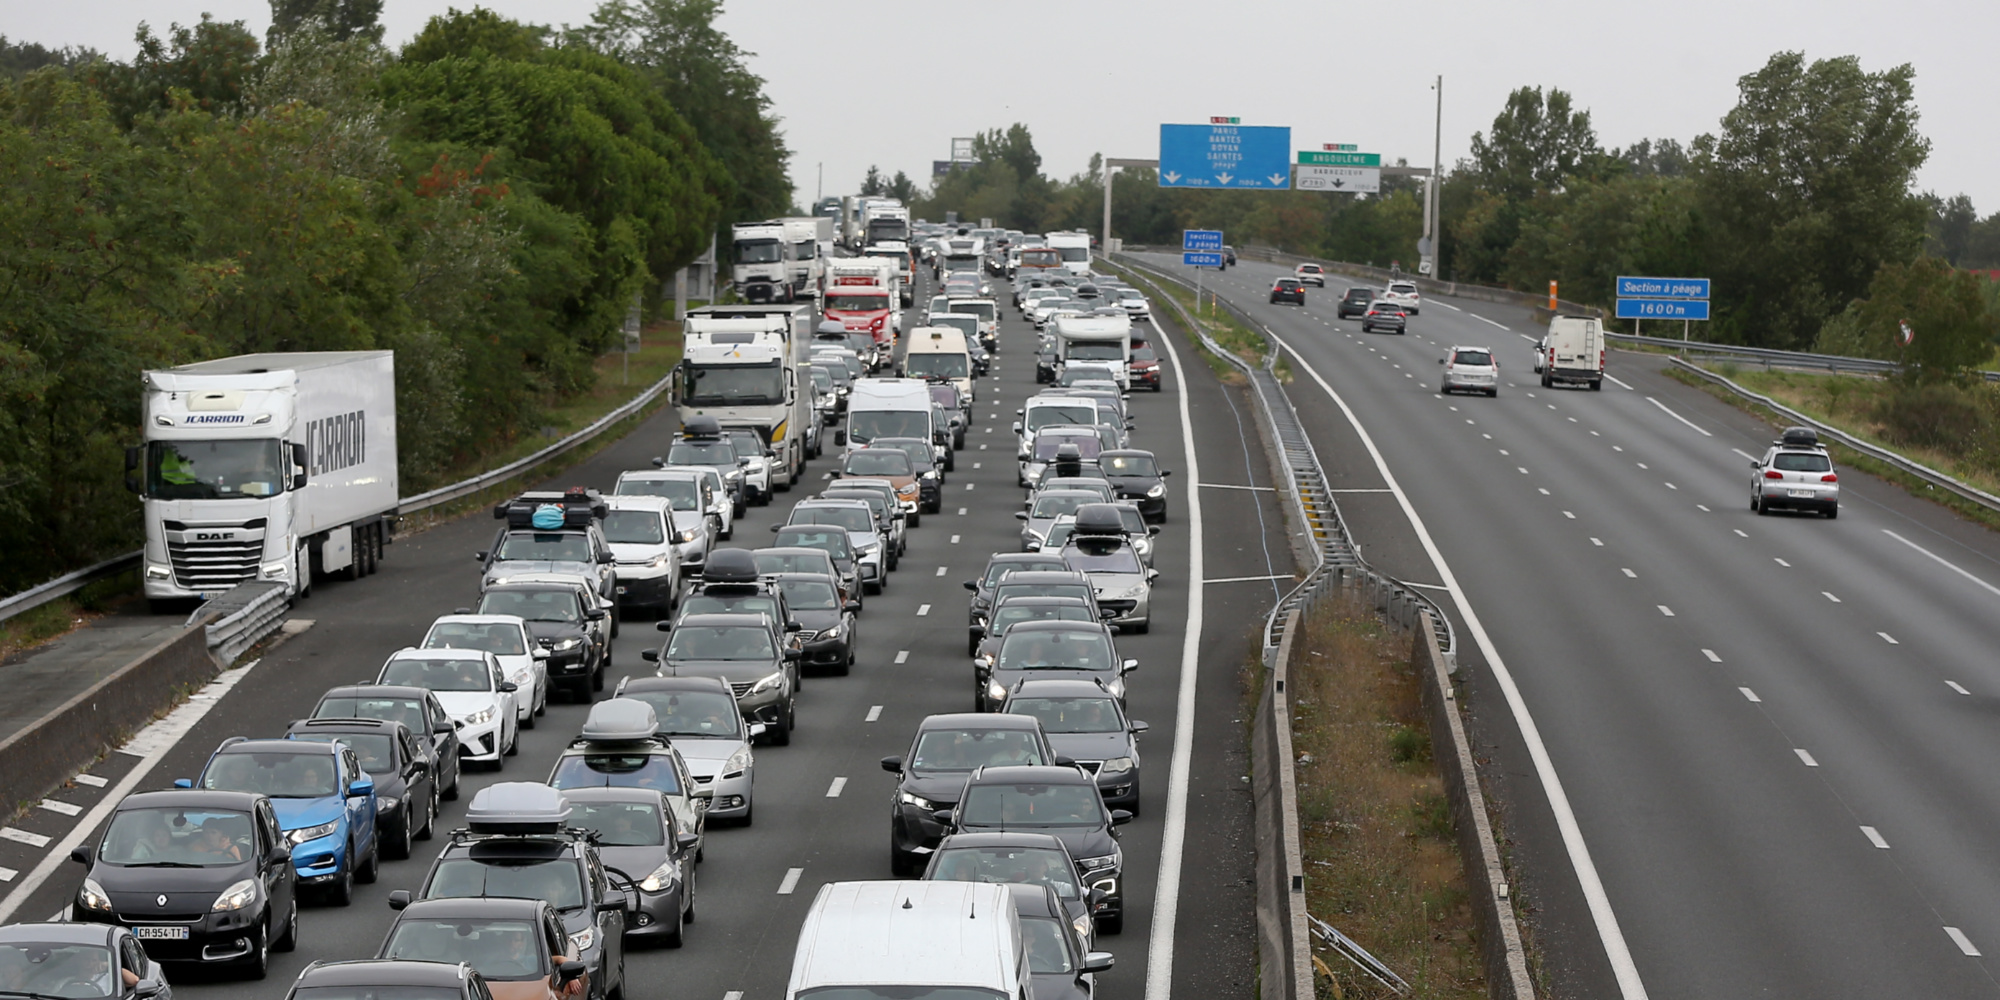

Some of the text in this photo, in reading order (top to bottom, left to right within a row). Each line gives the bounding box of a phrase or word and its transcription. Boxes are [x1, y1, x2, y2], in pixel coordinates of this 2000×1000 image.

[1212, 127, 1238, 135] PARIS
[1209, 135, 1241, 144] NANTES
[1211, 144, 1239, 152] ROYAN
[1207, 152, 1242, 161] SAINTES
[1313, 153, 1366, 164] ANGOULÊME
[1624, 281, 1702, 297] Section à péage
[184, 415, 245, 424] JCARRION
[196, 532, 235, 541] DAF
